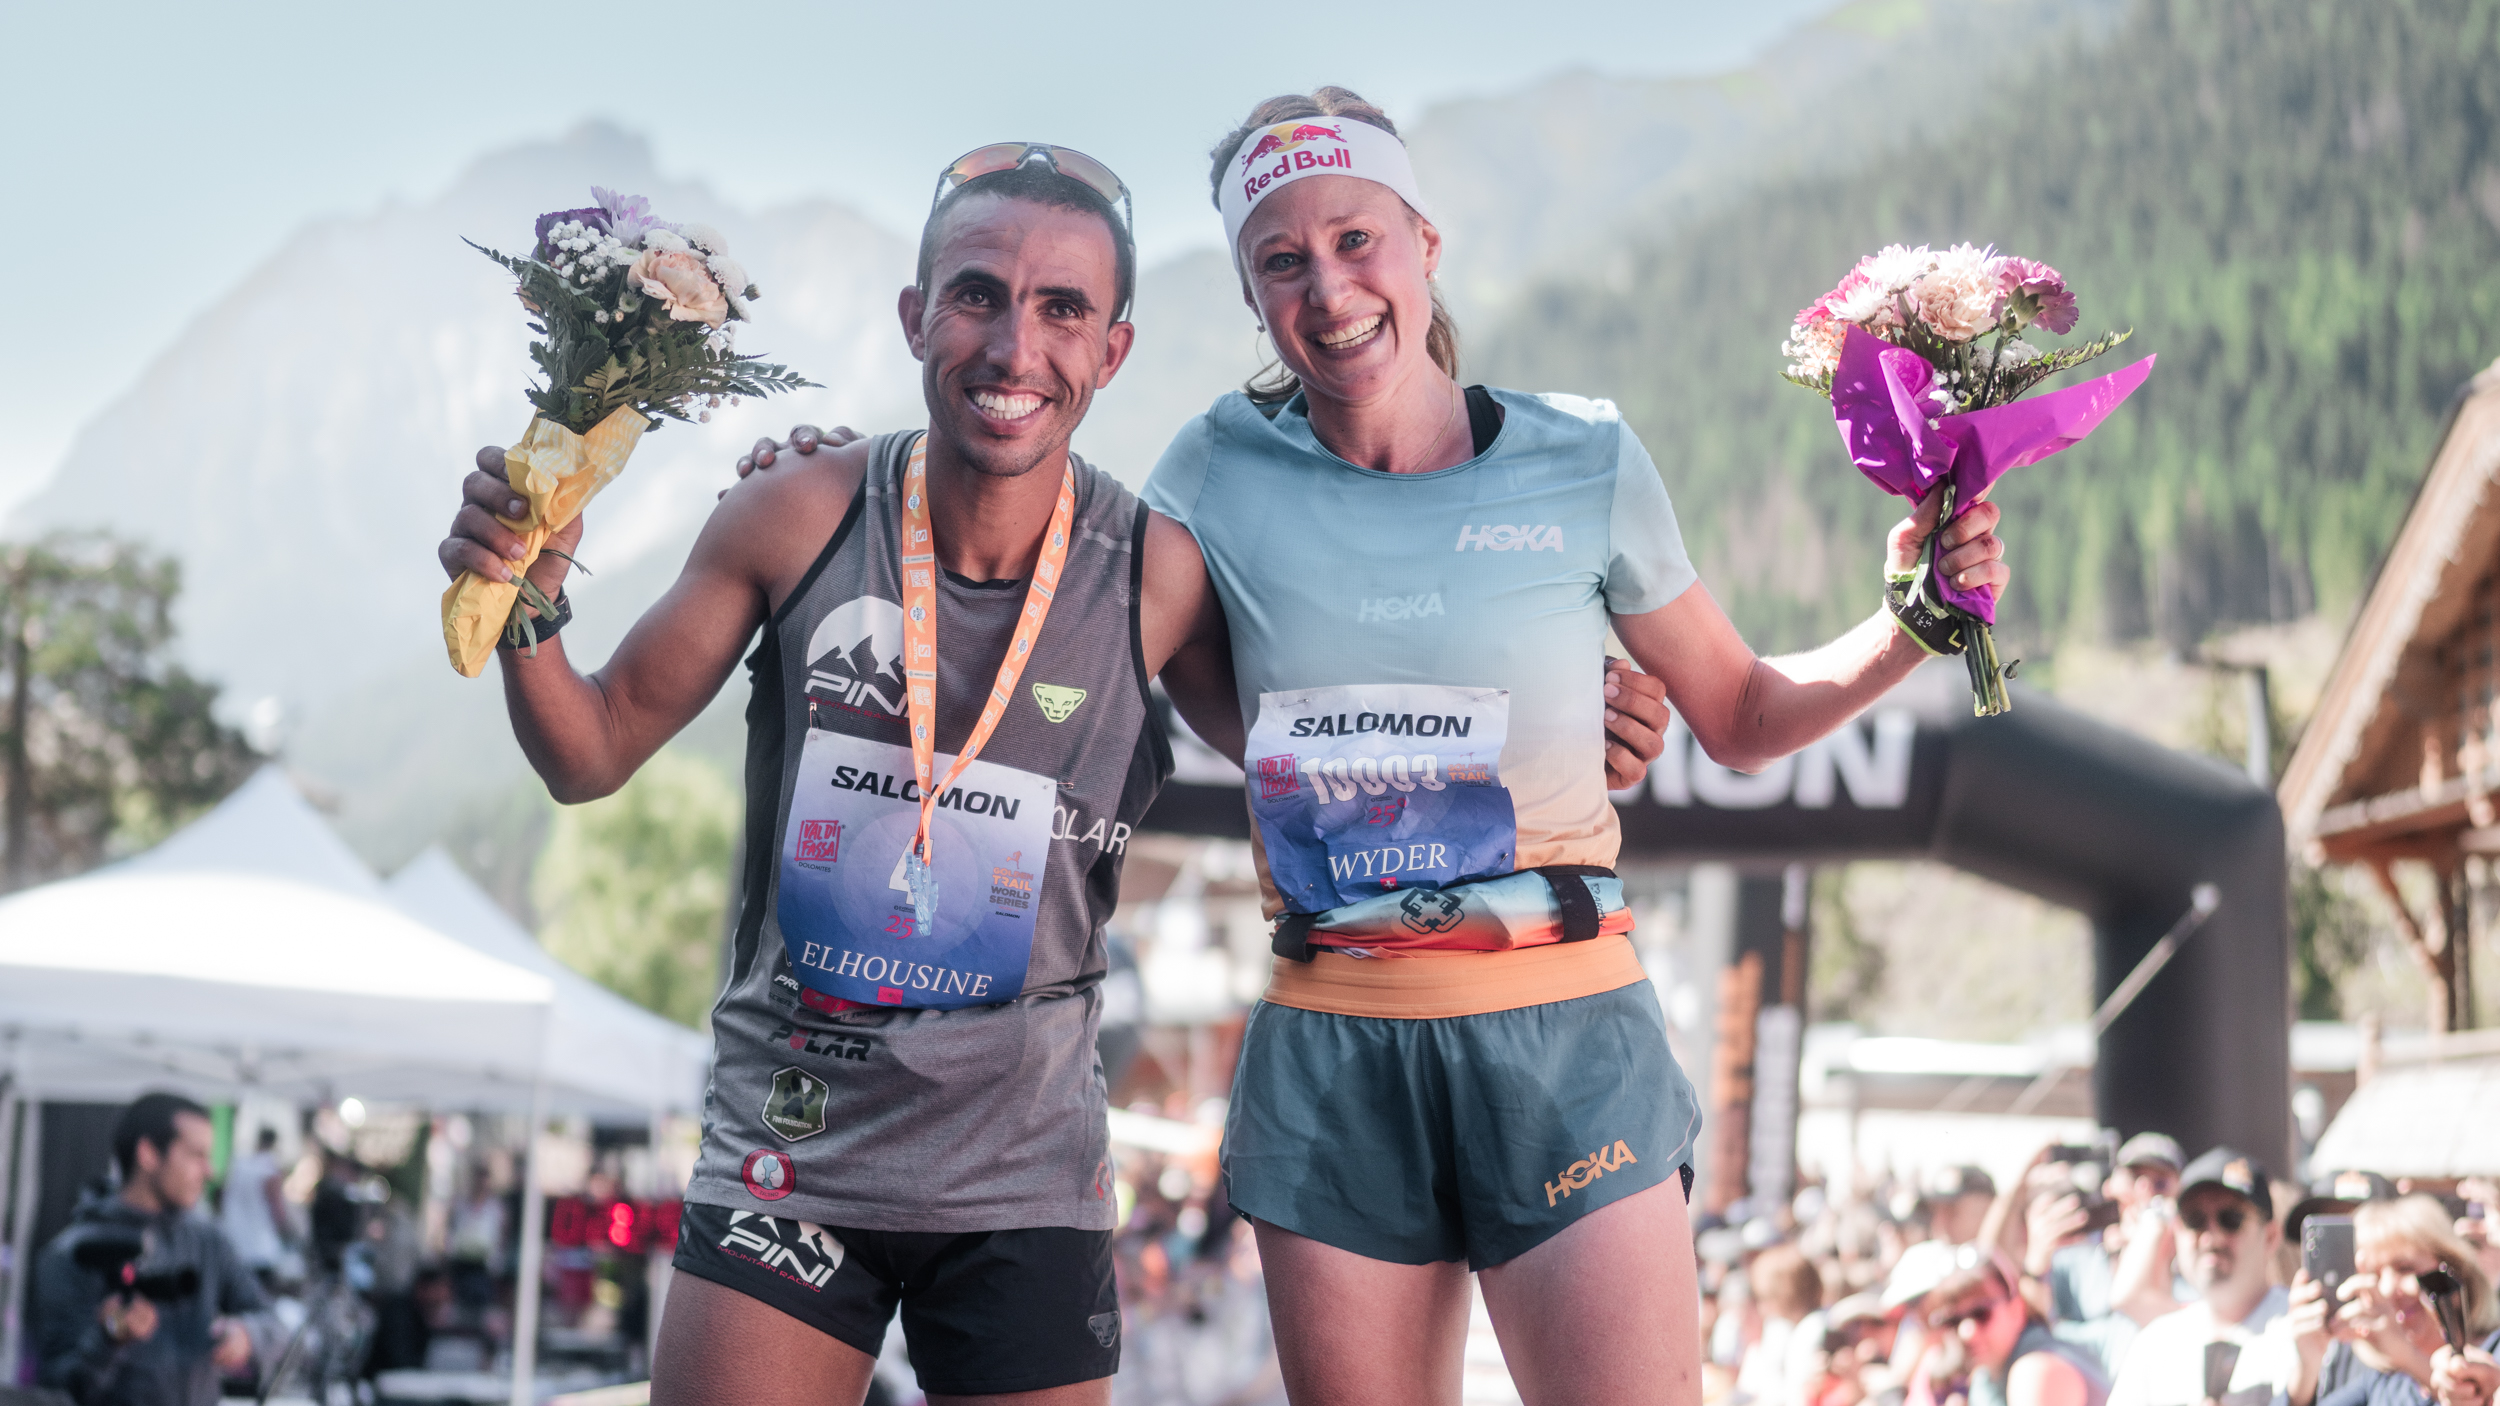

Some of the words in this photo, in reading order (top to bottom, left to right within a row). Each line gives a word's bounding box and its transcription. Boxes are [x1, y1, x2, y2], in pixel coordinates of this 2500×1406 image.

[1244, 154, 1291, 203] Red
[1294, 148, 1352, 171] Bull
[1454, 524, 1564, 553] HOKA
[1357, 592, 1445, 623] HOKA
[804, 669, 909, 718] PIN
[1289, 711, 1472, 738] SALOMON
[1447, 763, 1489, 771] GOLDEN
[1448, 771, 1491, 781] TRAIL
[830, 765, 1021, 821] SALOMON
[1050, 805, 1132, 856] OLAR
[993, 867, 1034, 881] GOLDEN
[1328, 843, 1449, 882] WYDER
[991, 885, 1031, 900] WORLD
[992, 874, 1033, 892] TRAIL
[989, 895, 1029, 910] SERIES
[800, 940, 993, 998] ELHOUSINE
[767, 1024, 872, 1061] POLAR
[1544, 1139, 1638, 1208] HOKA
[717, 1245, 777, 1273] MOUNTAIN
[779, 1270, 821, 1293] RACING
[719, 1226, 836, 1288] PINI
